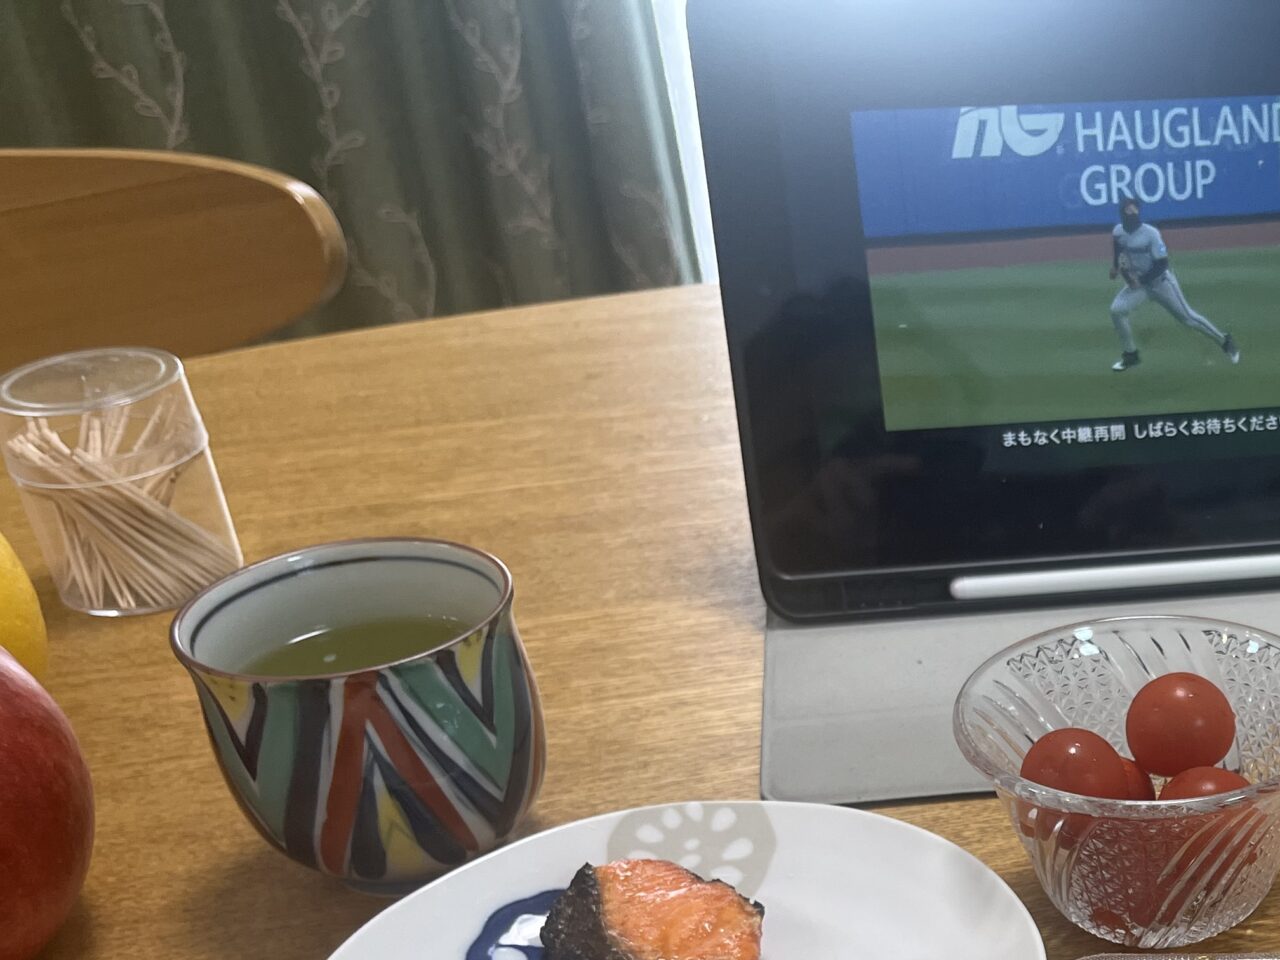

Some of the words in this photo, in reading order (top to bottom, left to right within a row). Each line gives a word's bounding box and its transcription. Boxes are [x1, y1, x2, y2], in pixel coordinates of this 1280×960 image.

[1080, 159, 1216, 206] GROUP
[1002, 424, 1126, 447] まもなく中継再開
